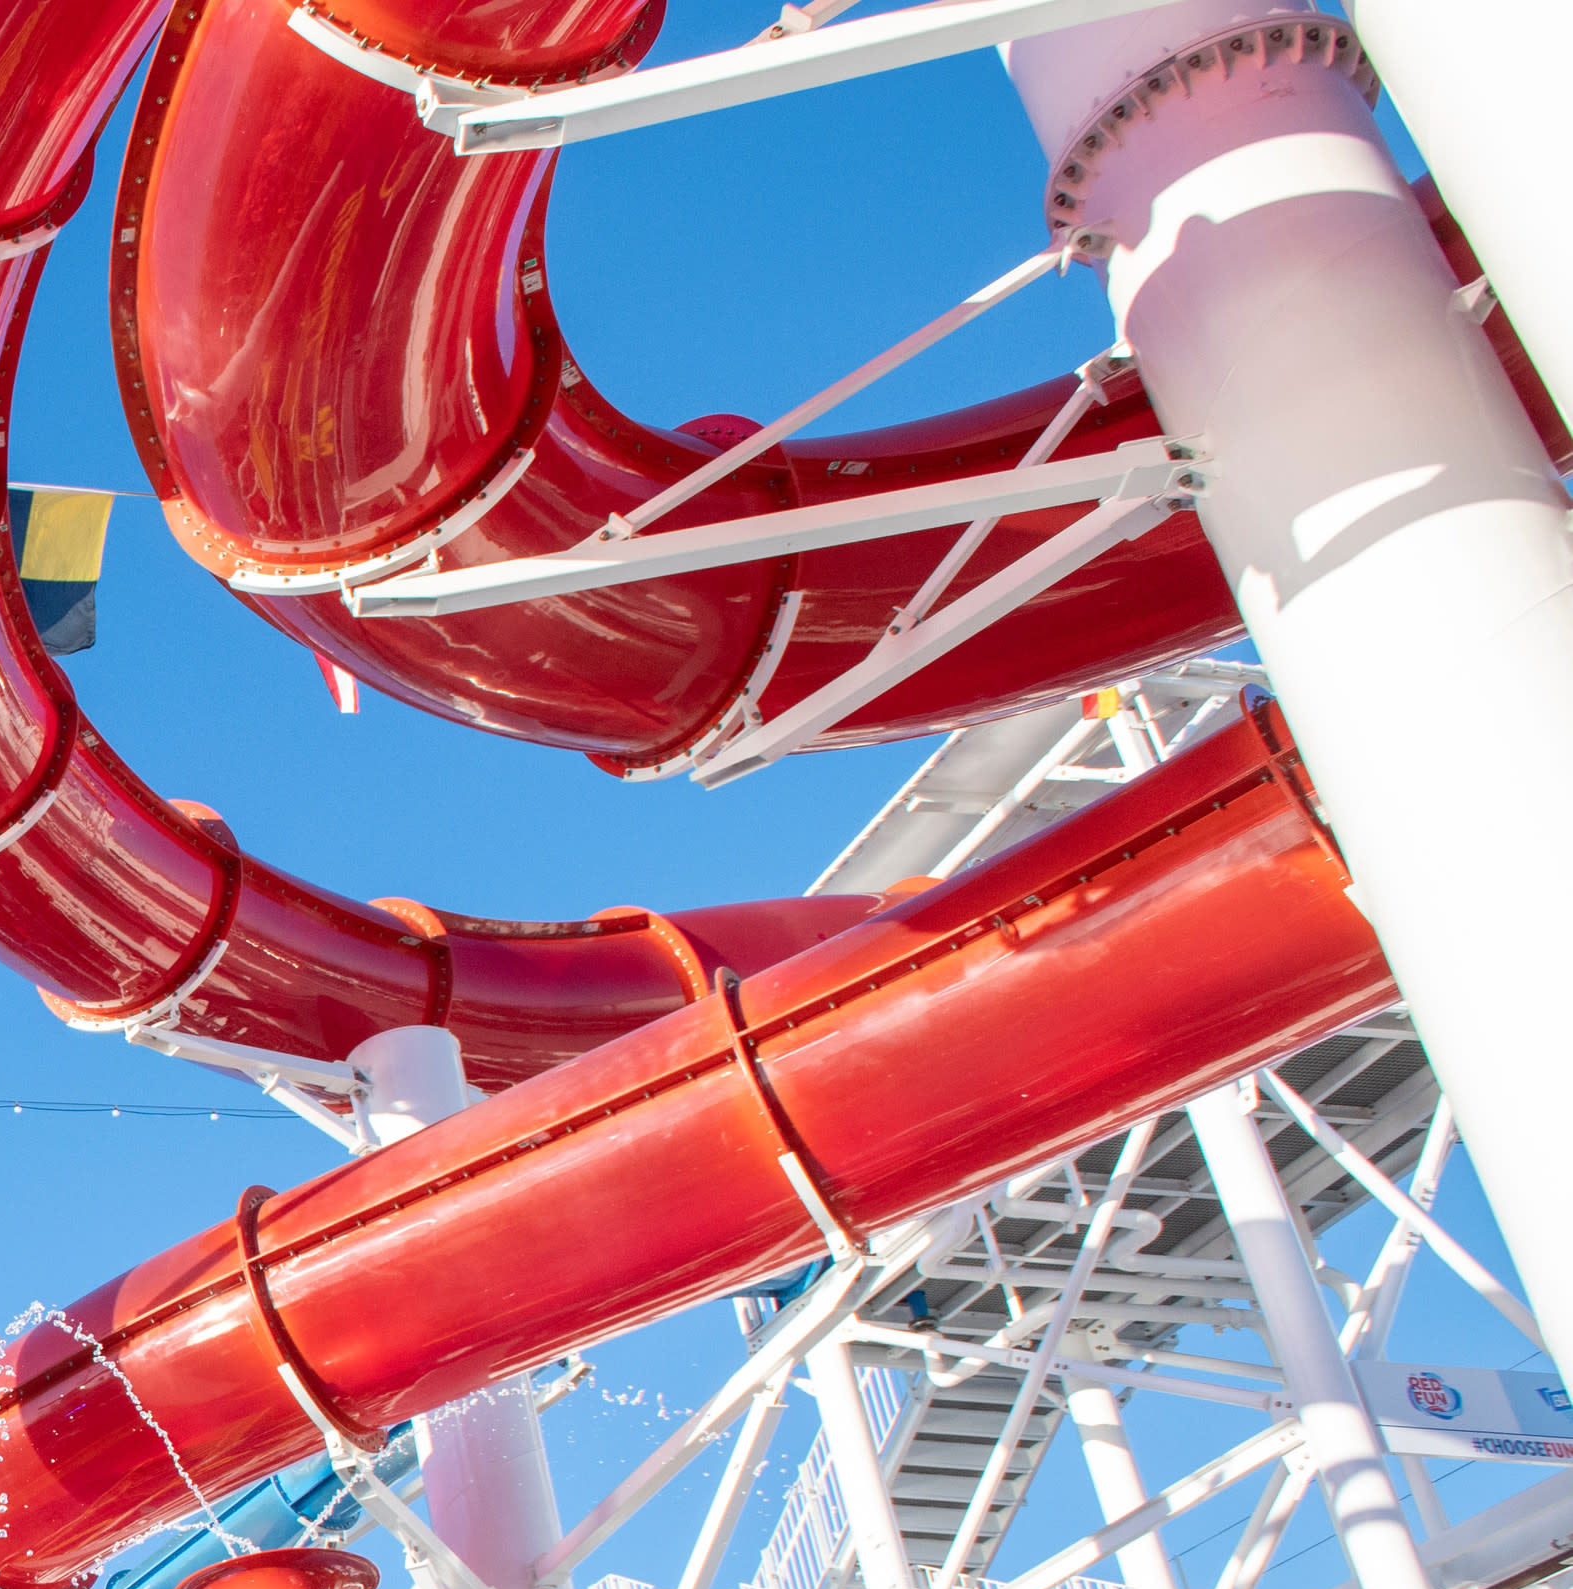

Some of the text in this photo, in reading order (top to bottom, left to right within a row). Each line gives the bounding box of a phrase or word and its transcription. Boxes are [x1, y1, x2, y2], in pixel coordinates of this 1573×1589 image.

[1408, 1376, 1442, 1391] RED
[1414, 1391, 1448, 1405] FUN
[1471, 1437, 1573, 1458] #CHOOSEFUN
